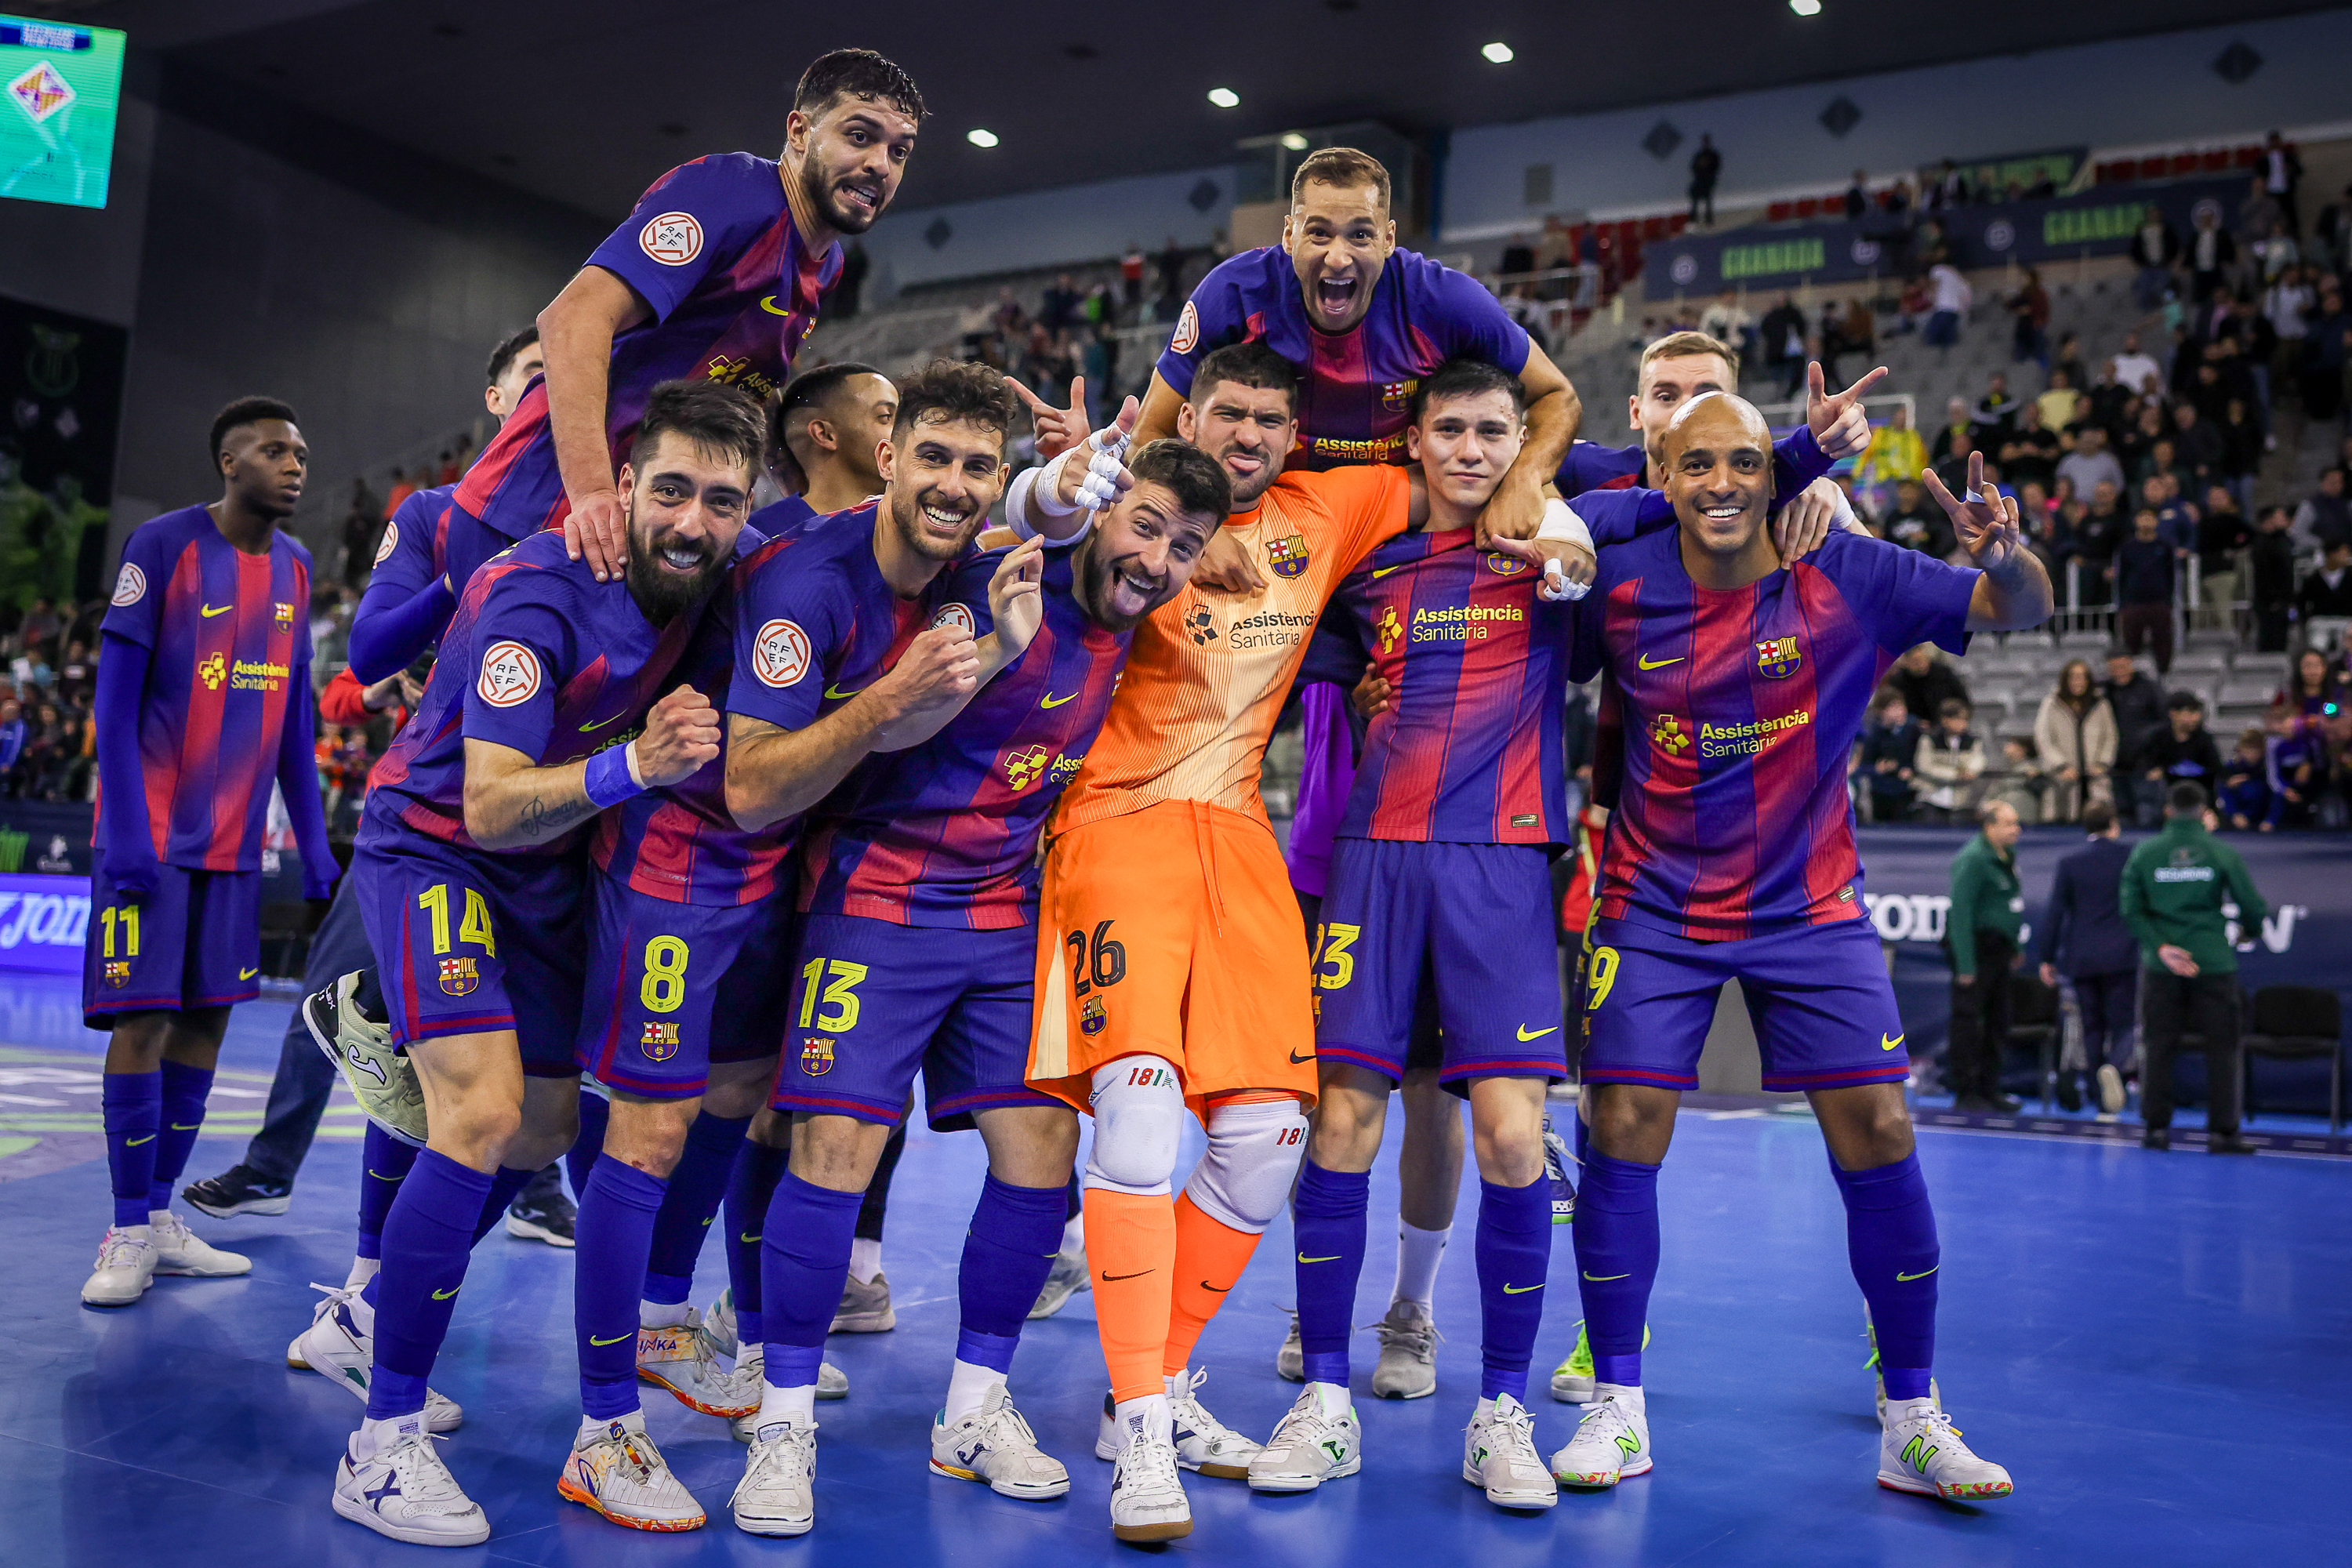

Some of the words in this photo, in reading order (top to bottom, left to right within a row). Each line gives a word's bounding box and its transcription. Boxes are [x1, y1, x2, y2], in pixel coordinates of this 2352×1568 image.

[1314, 437, 1408, 452] Assistènc
[1229, 611, 1318, 634] Assistènci
[1412, 604, 1523, 625] Assistència
[1230, 629, 1300, 649] Sanitària
[1411, 622, 1488, 643] Sanitària
[1700, 709, 1809, 740] Assistència
[1701, 734, 1778, 758] Sanitària
[101, 904, 140, 958] 11
[418, 884, 496, 960] 14
[640, 934, 690, 1014] 8
[1066, 920, 1127, 1001] 26
[1588, 946, 1621, 1010] 9
[798, 957, 869, 1033] 13
[1127, 1067, 1164, 1087] 181
